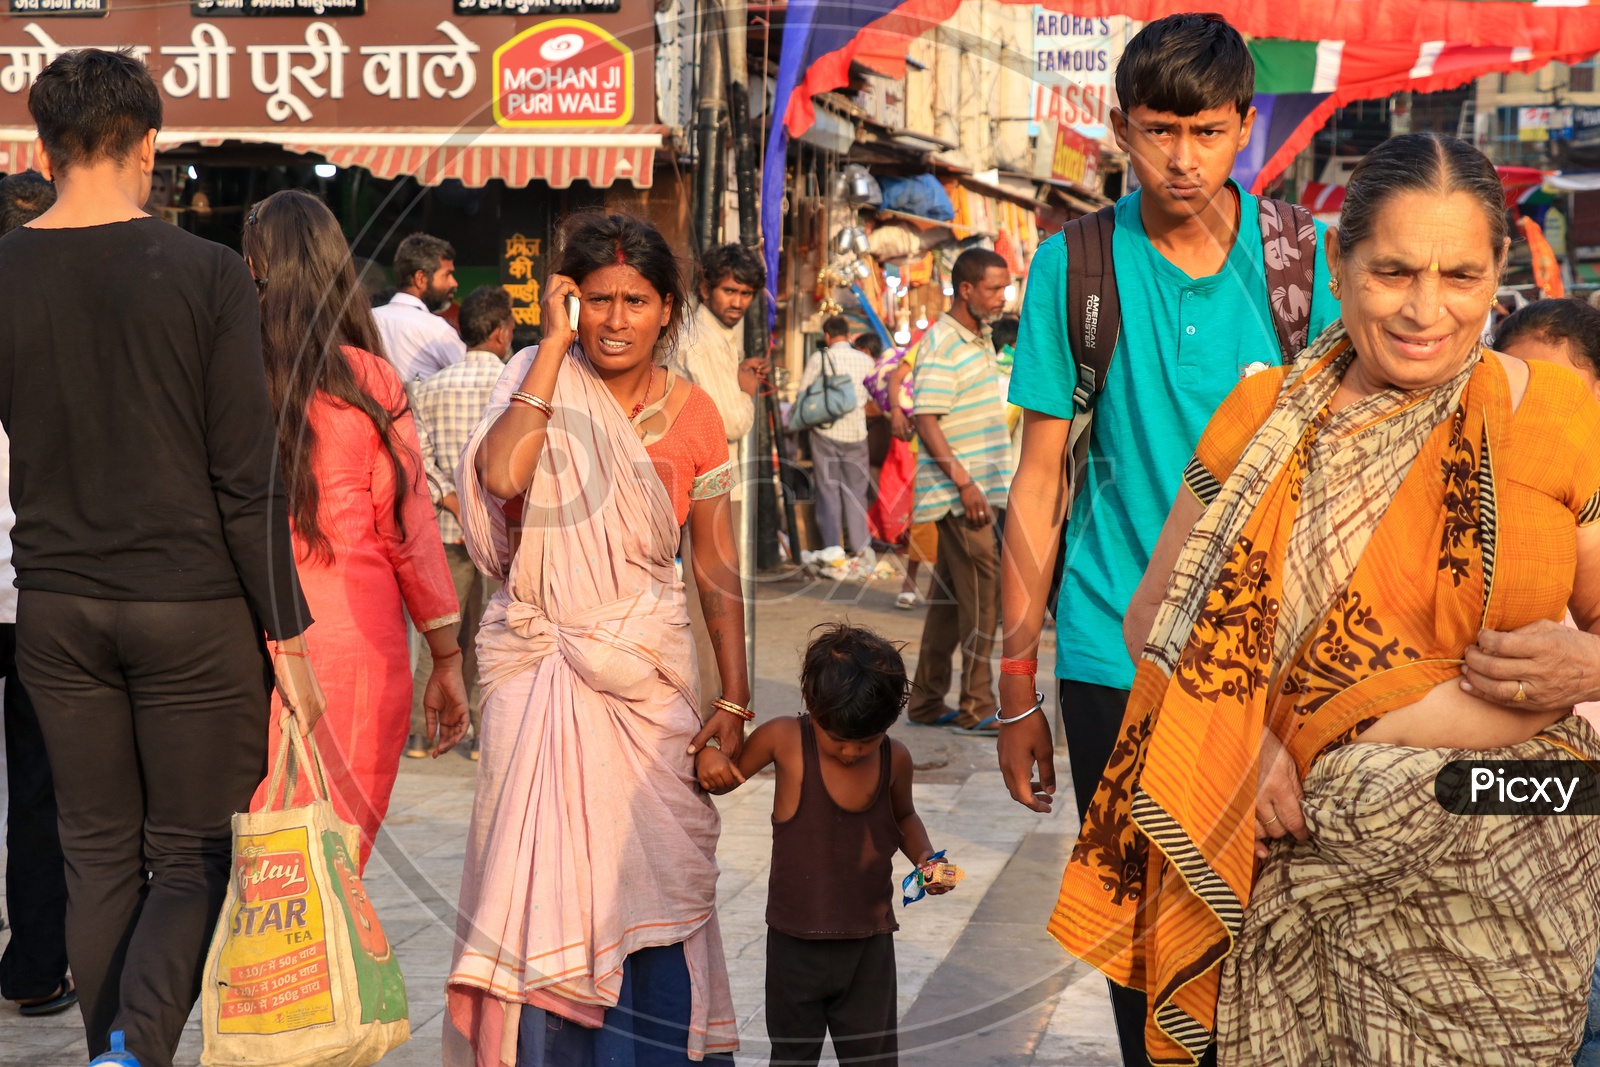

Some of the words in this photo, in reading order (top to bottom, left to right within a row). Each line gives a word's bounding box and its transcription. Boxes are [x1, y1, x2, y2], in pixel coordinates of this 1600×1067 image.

[1036, 15, 1109, 36] ARORA'S
[161, 22, 236, 99] जी
[246, 21, 350, 122] पूरी
[359, 20, 480, 100] वाले
[1037, 50, 1107, 72] FAMOUS
[504, 66, 597, 91] MOHAN
[602, 66, 620, 89] JI
[508, 92, 552, 115] PURI
[557, 92, 616, 114] WALE
[509, 256, 534, 279] की
[1084, 294, 1094, 348] TOURISTER
[1090, 294, 1100, 349] AMERICAN
[232, 897, 307, 936] STAR
[284, 930, 313, 945] TEA
[279, 955, 297, 968] 50g
[299, 946, 317, 960] चाय
[271, 974, 298, 990] 100g
[299, 963, 318, 977] चाय
[272, 990, 299, 1007] 250g
[301, 980, 320, 995] चाय
